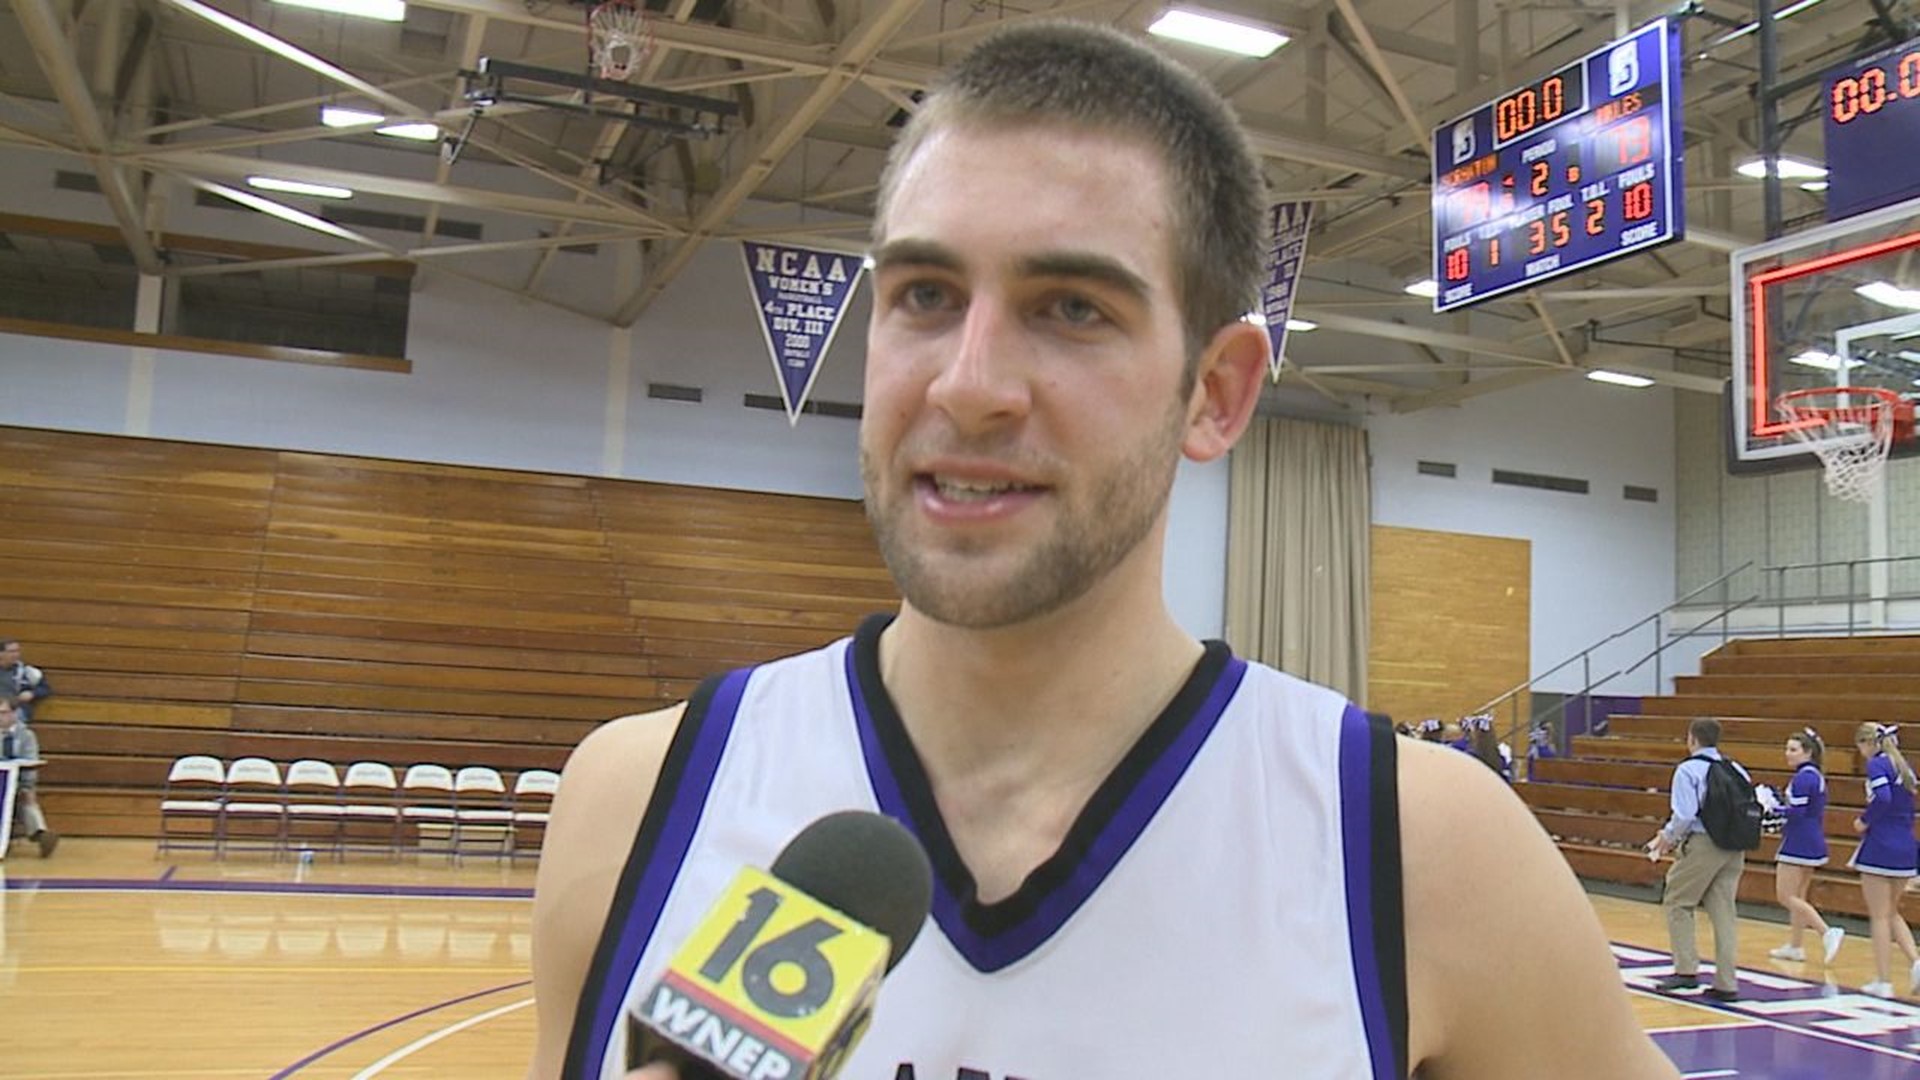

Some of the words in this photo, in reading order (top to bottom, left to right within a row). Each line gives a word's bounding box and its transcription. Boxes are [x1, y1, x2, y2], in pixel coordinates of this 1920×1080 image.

[1833, 52, 1920, 123] 00.0
[1497, 77, 1563, 140] 00.0
[1522, 139, 1557, 163] PERIOD
[1532, 162, 1548, 196] 2
[1618, 162, 1656, 189] FOULS
[1587, 200, 1604, 235] 2
[1624, 182, 1653, 220] 10
[1620, 221, 1659, 247] SCORE
[757, 248, 847, 282] NCAA
[1447, 247, 1470, 281] 10
[1490, 239, 1499, 265] 1
[769, 276, 834, 295] WOMEN'S
[773, 317, 801, 332] DIV.
[804, 321, 824, 335] III
[787, 303, 835, 320] PLACE
[698, 885, 845, 1020] 16
[651, 985, 792, 1080] WNEP
